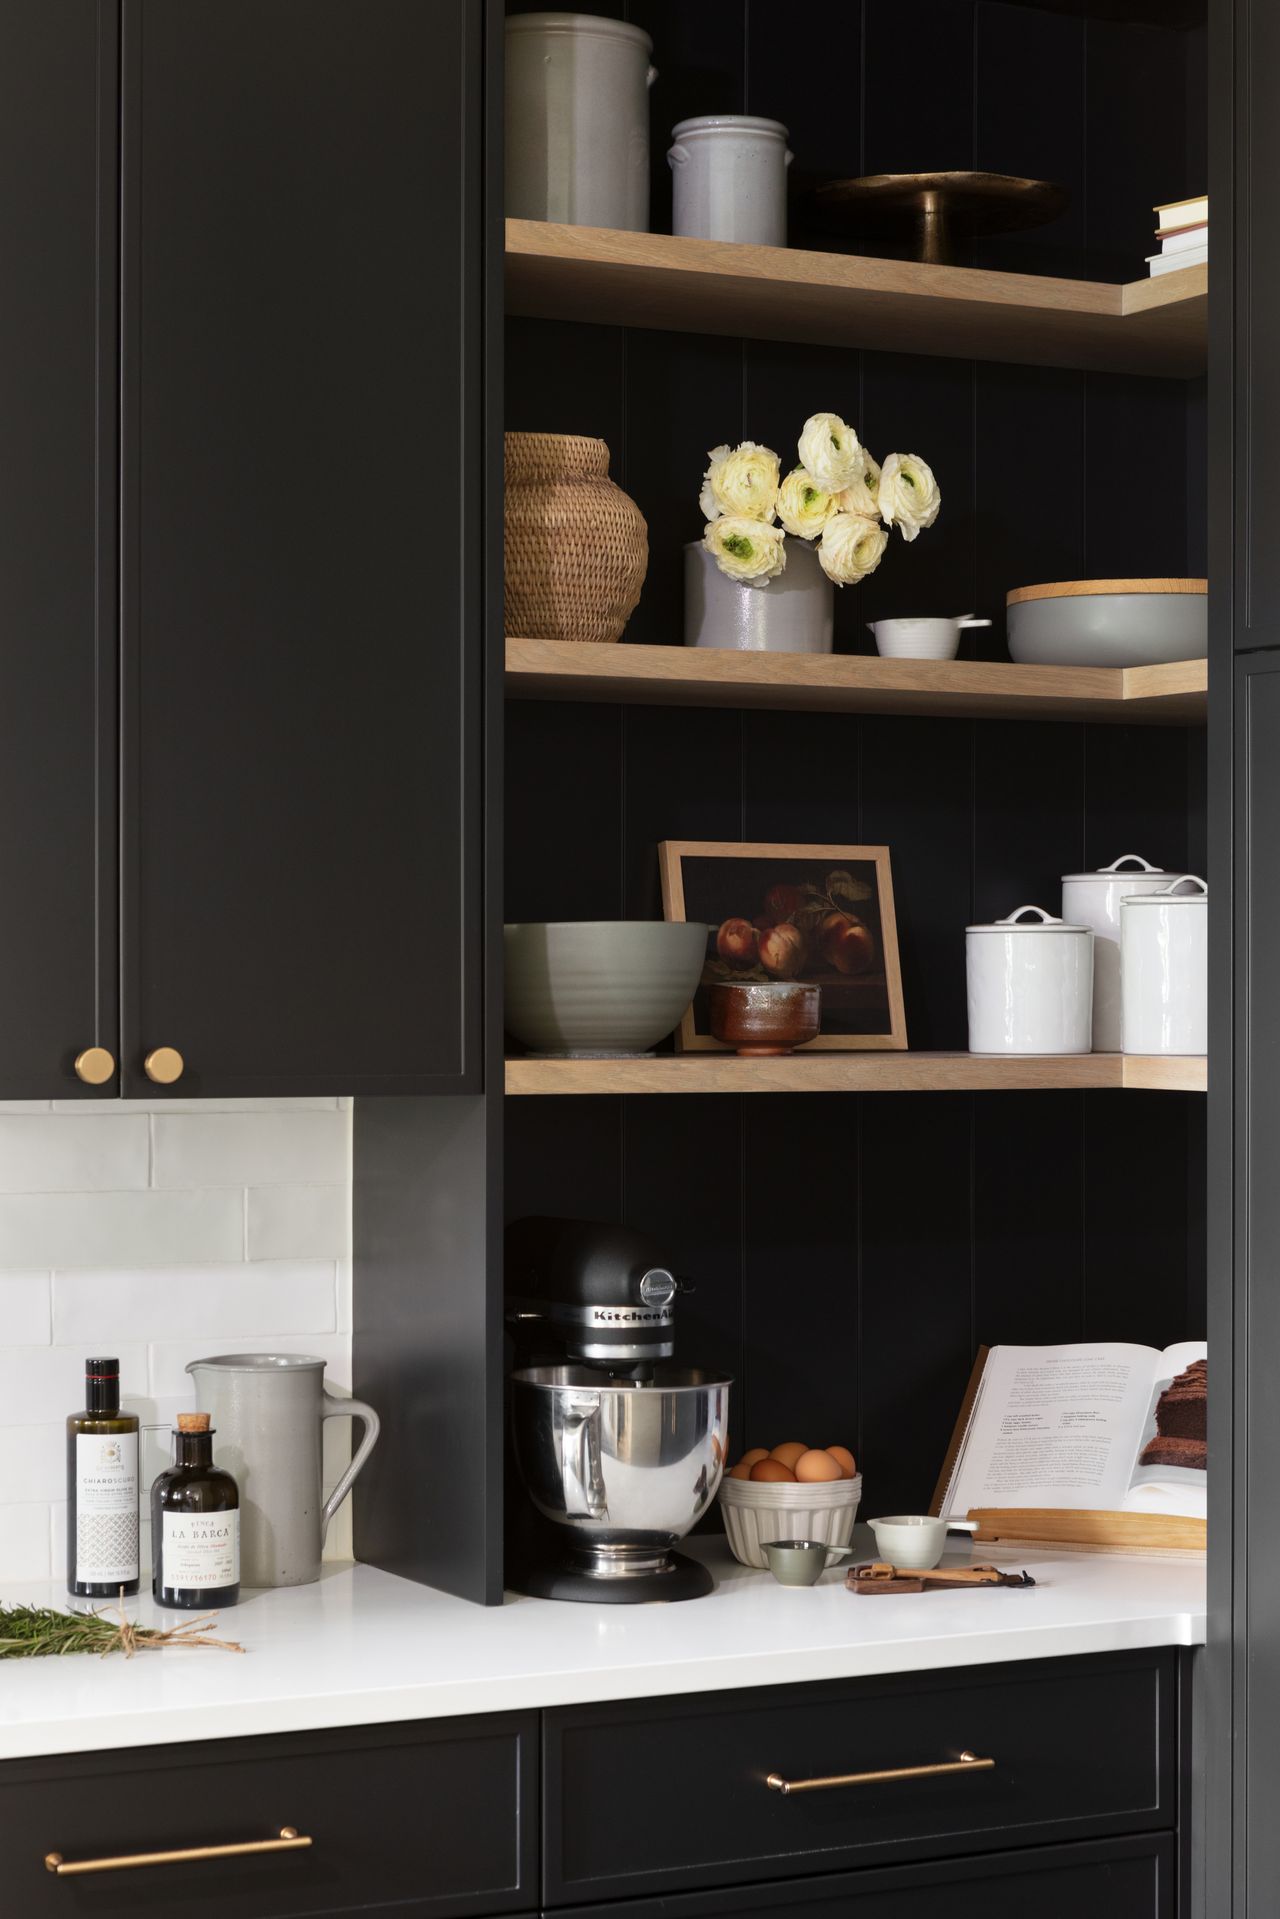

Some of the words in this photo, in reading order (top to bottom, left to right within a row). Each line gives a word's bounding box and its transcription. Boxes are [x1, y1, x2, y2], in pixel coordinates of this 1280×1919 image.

[594, 1309, 673, 1321] KitchenAi
[172, 1530, 185, 1538] LA
[193, 1528, 229, 1538] BARCA
